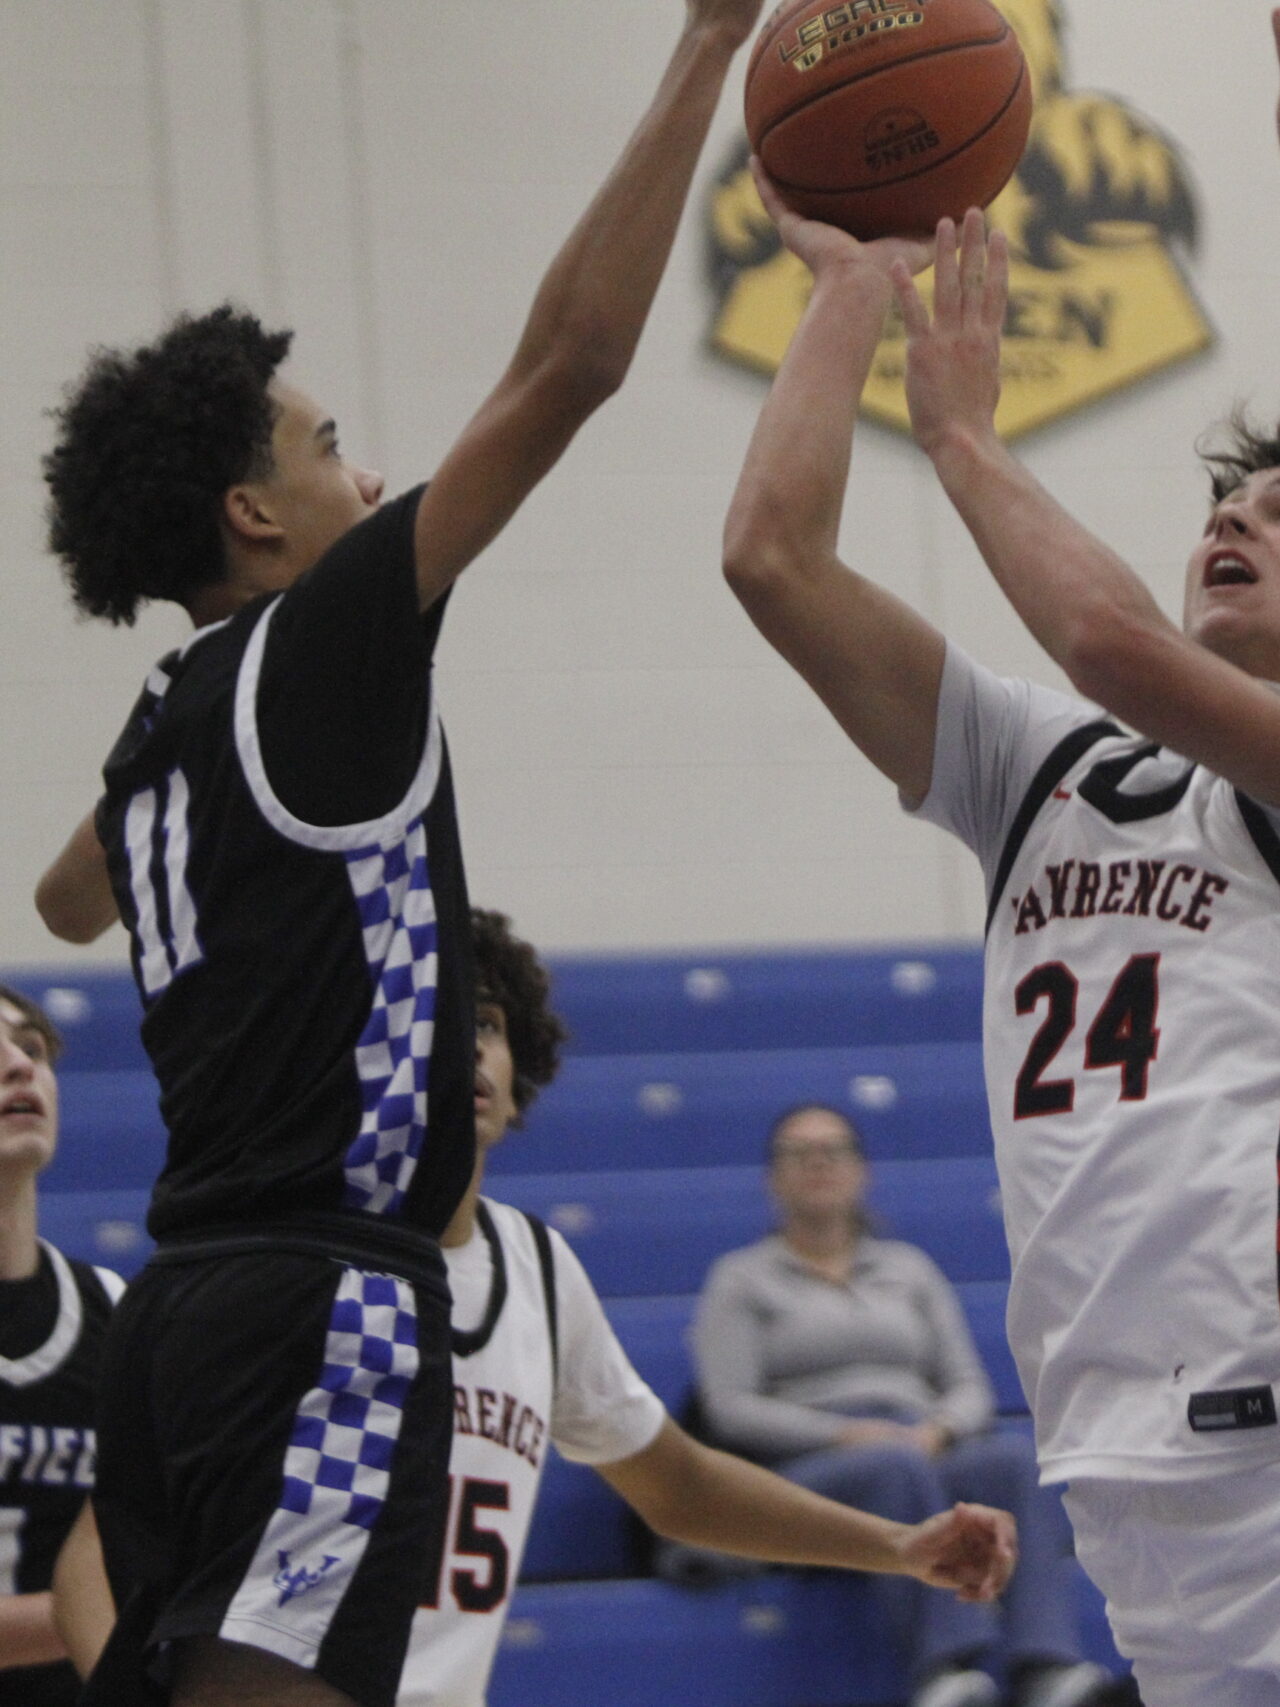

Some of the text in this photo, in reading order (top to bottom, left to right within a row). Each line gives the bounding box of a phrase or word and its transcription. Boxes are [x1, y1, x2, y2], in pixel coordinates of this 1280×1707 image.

[126, 767, 204, 994] 11
[1013, 952, 1161, 1121] 24
[1246, 1398, 1263, 1416] M
[416, 1473, 510, 1614] 5
